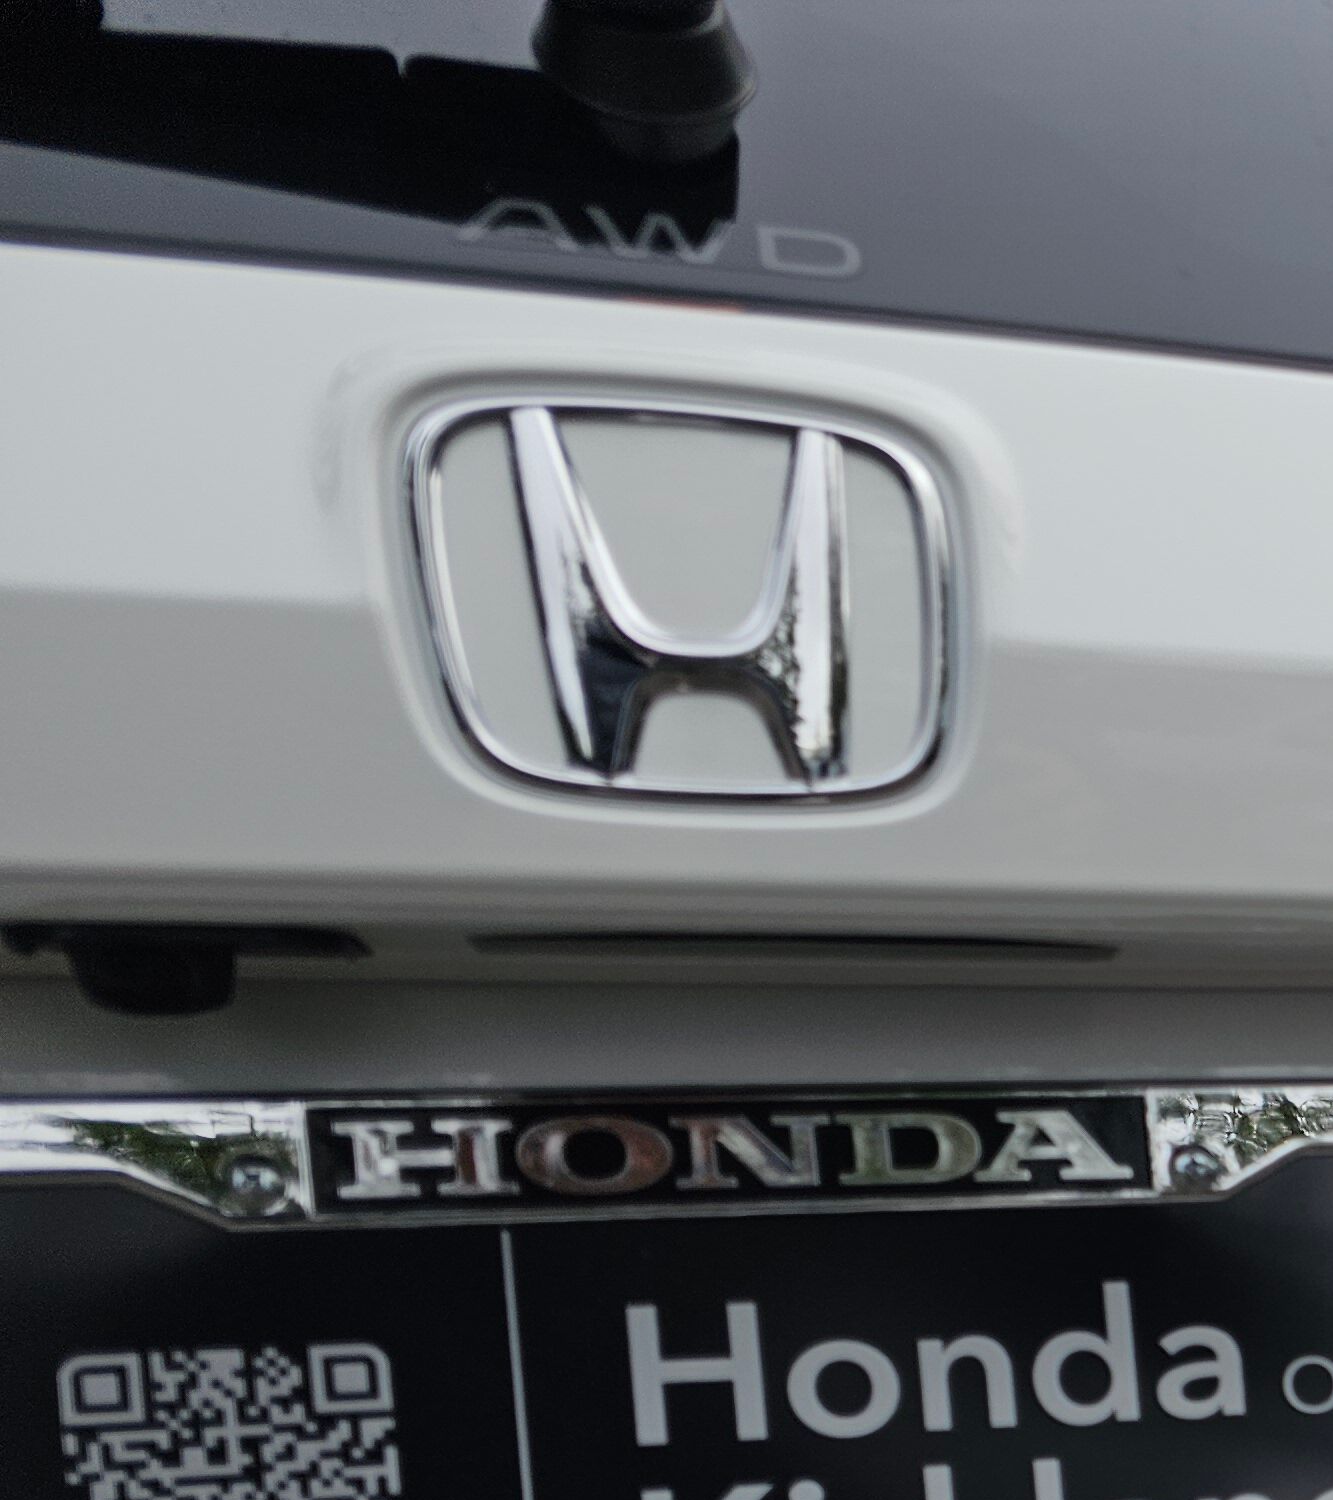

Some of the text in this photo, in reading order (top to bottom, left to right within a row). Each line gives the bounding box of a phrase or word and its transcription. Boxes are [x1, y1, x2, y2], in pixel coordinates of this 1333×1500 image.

[458, 199, 862, 278] AWD
[333, 1109, 1133, 1201] HONDA
[625, 1280, 1248, 1447] Honda
